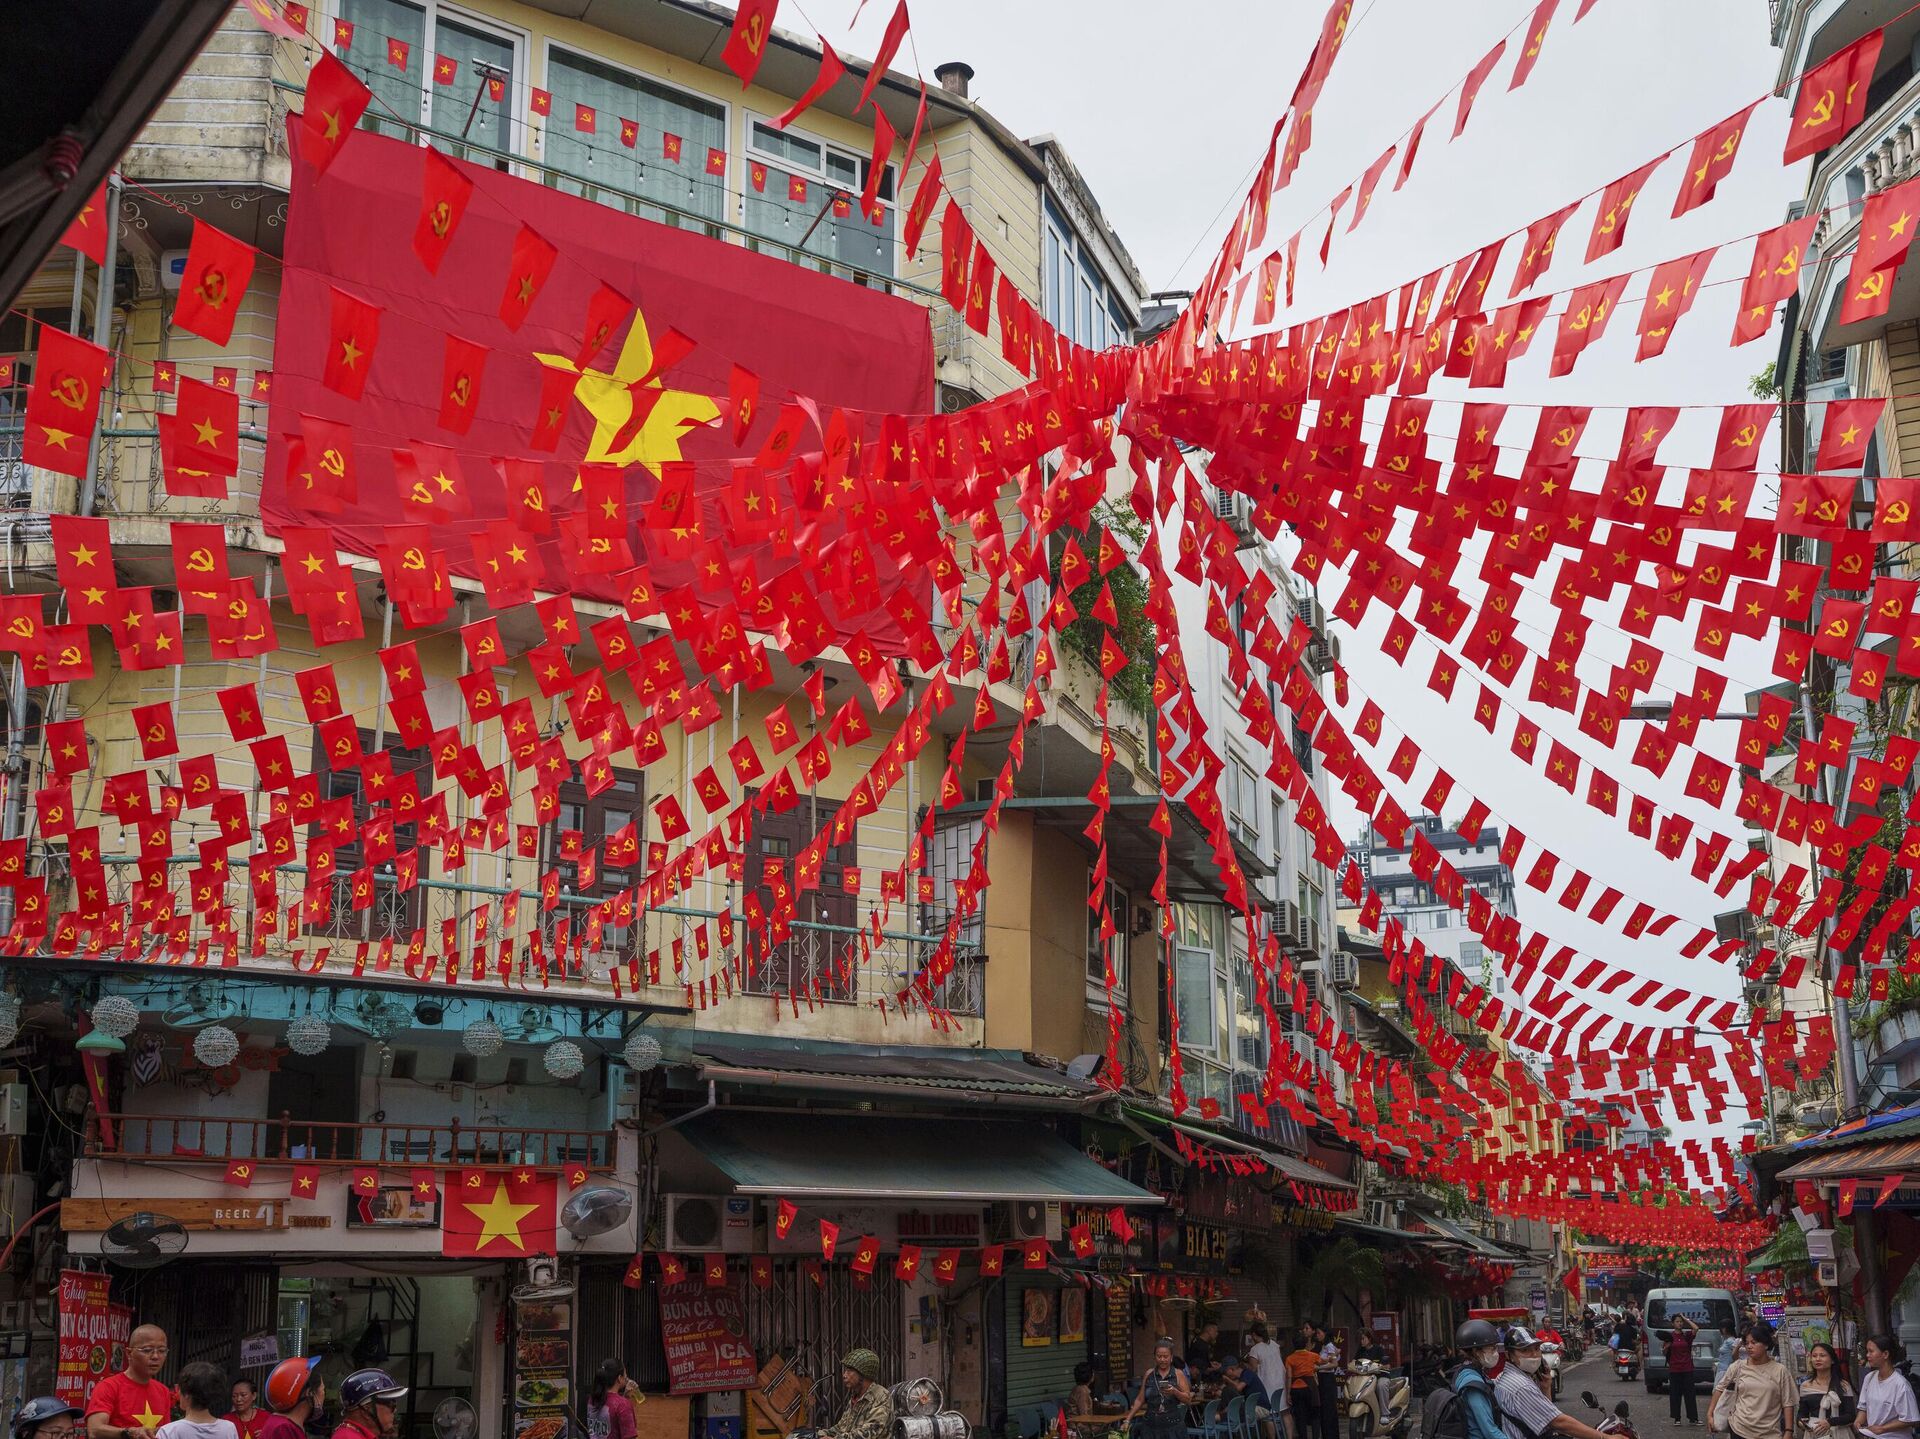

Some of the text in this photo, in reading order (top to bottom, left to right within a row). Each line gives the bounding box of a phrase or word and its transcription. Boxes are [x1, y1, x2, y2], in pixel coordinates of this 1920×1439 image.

[215, 1208, 251, 1219] BEER
[1185, 1225, 1227, 1262] BIA 29
[663, 1299, 691, 1321] BÚN
[669, 1343, 694, 1359] BÁNH
[720, 1342, 752, 1360] CÁ
